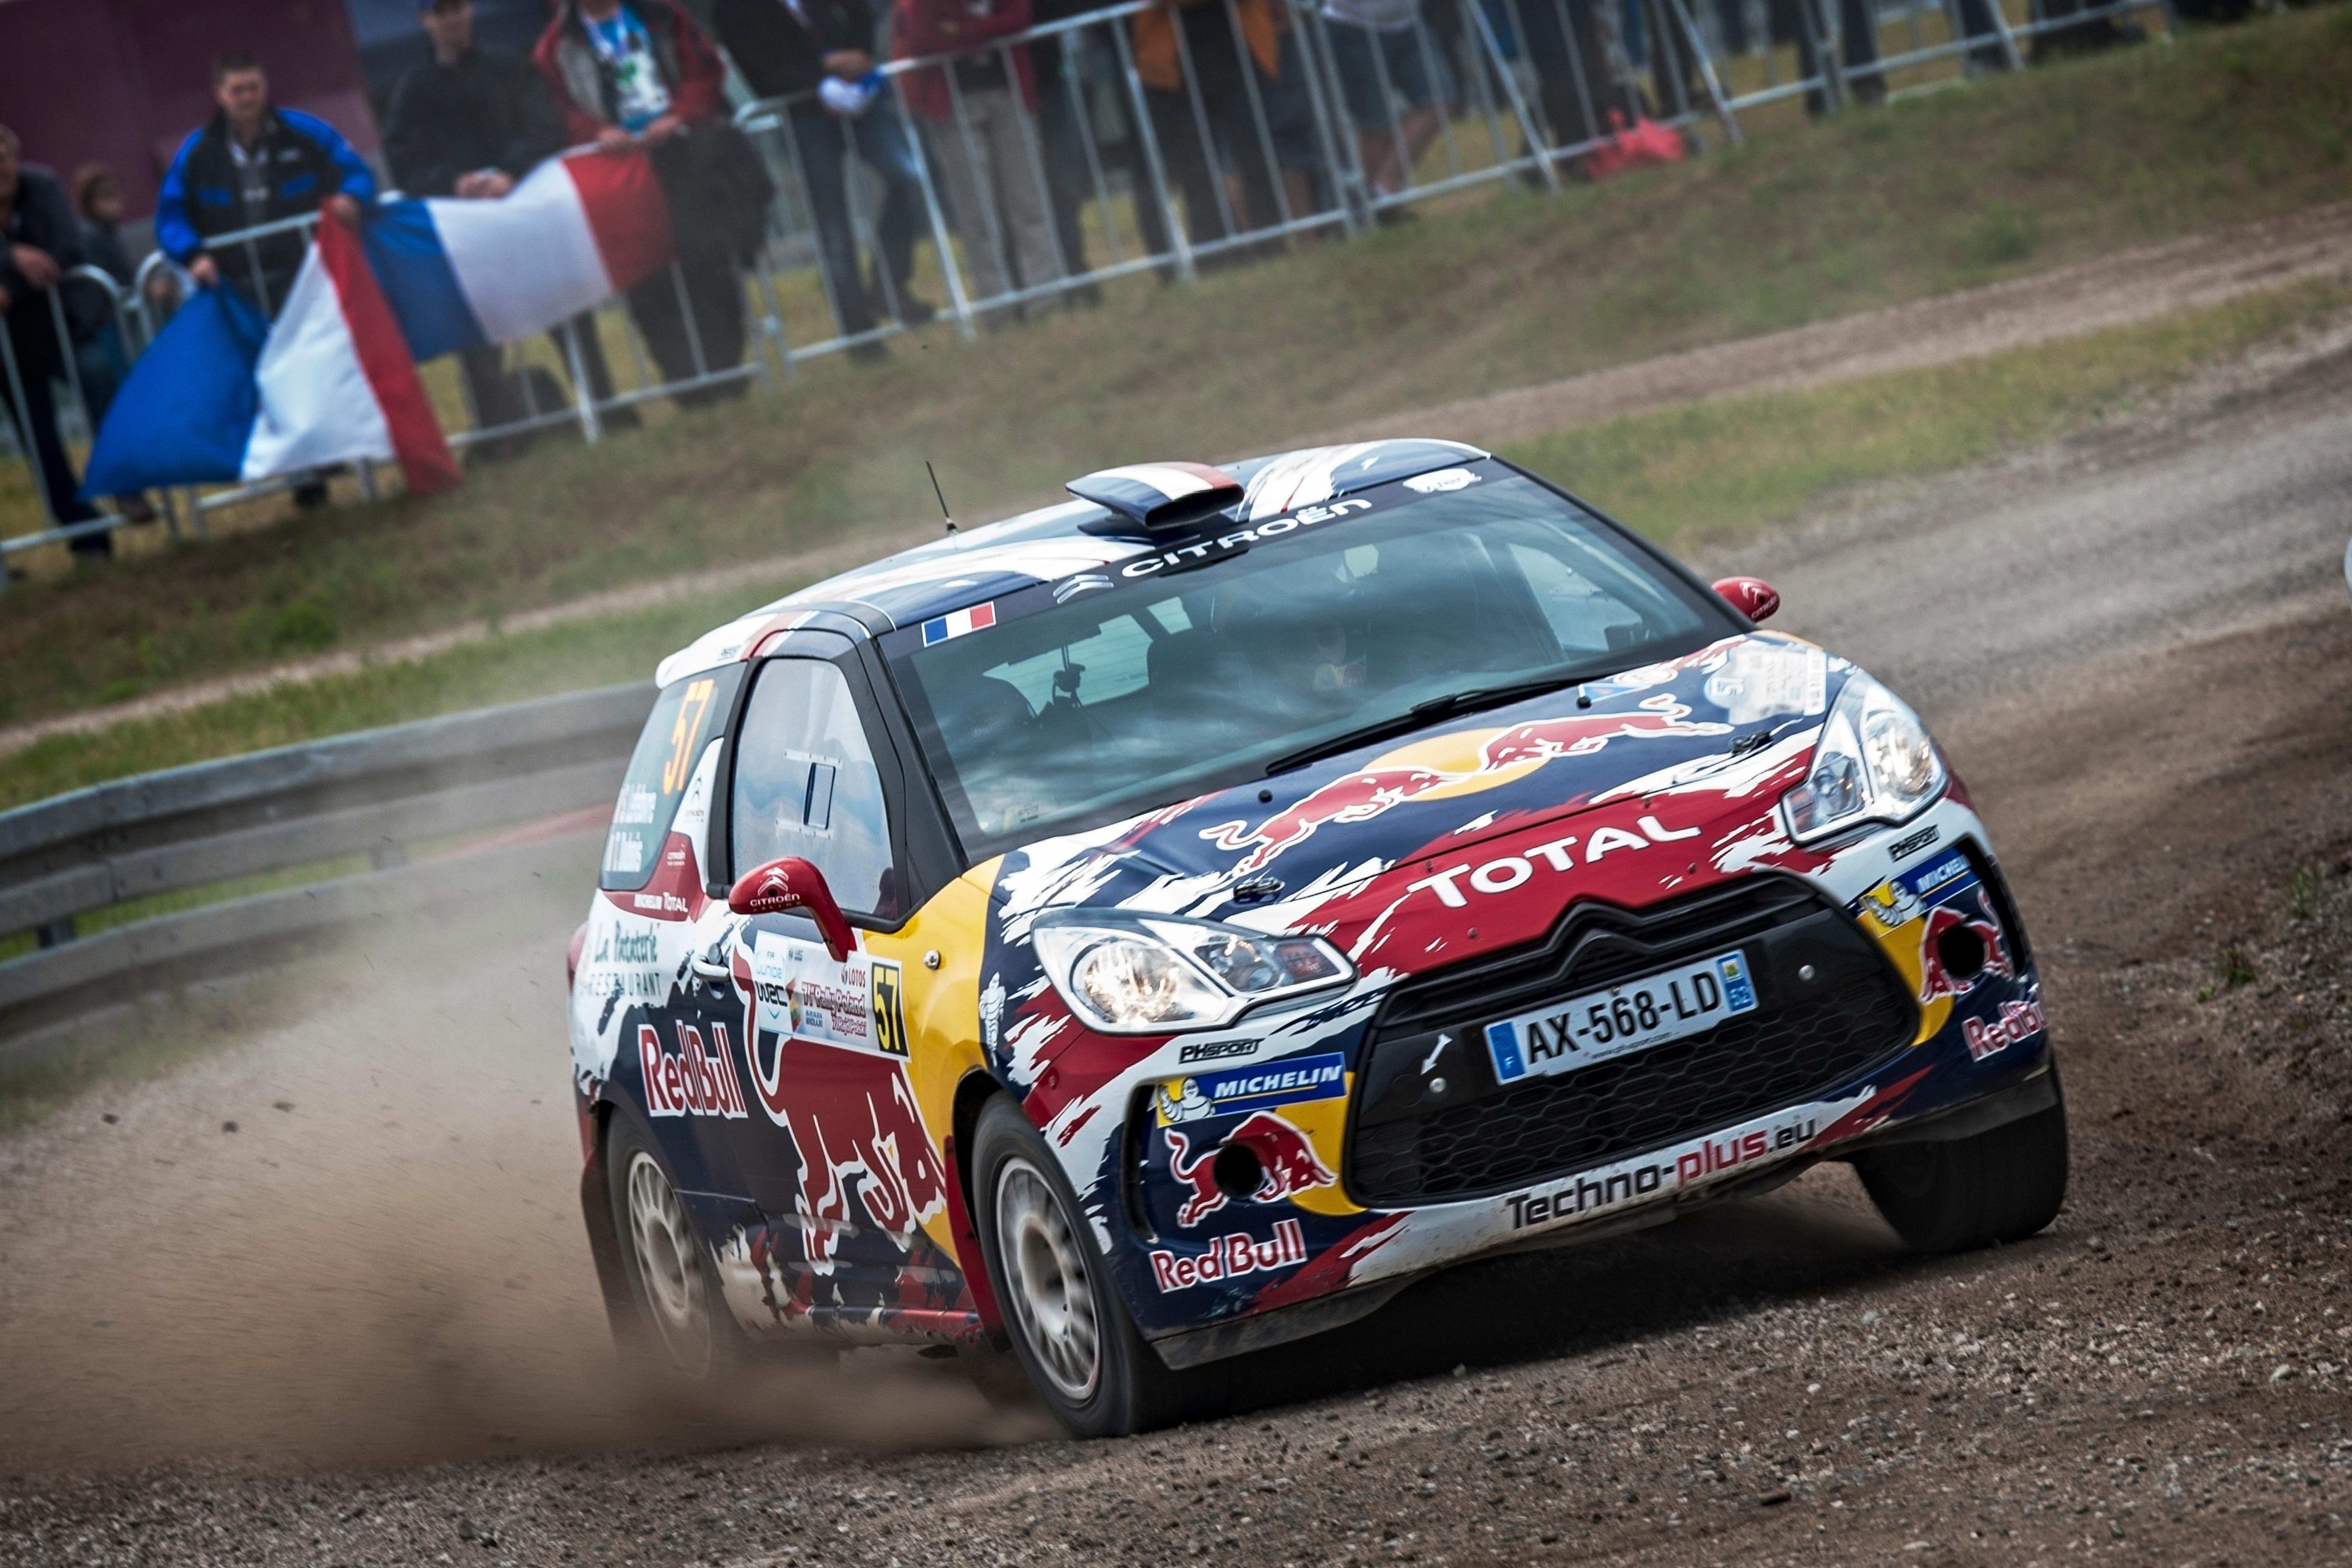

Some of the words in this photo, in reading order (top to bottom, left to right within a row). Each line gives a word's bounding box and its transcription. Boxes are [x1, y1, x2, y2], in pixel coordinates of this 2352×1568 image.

[1121, 499, 1372, 577] CITROËN
[663, 678, 715, 796] 57
[1406, 815, 1702, 908] TOTAL
[663, 891, 689, 912] TOTAL
[750, 893, 800, 907] CITROËN
[755, 980, 787, 1007] WRC
[835, 988, 866, 1018] Poland
[849, 967, 866, 988] LOTOS
[874, 965, 900, 1050] 57
[1526, 971, 1721, 1065] AX-568-LD
[1962, 1000, 2027, 1062] Red
[638, 1019, 705, 1118] Red
[685, 1022, 749, 1120] Bull
[1214, 1064, 1343, 1099] MICHELIN
[1503, 1056, 1514, 1070] F
[1148, 1236, 1225, 1294] Red
[1224, 1218, 1308, 1277] Bull
